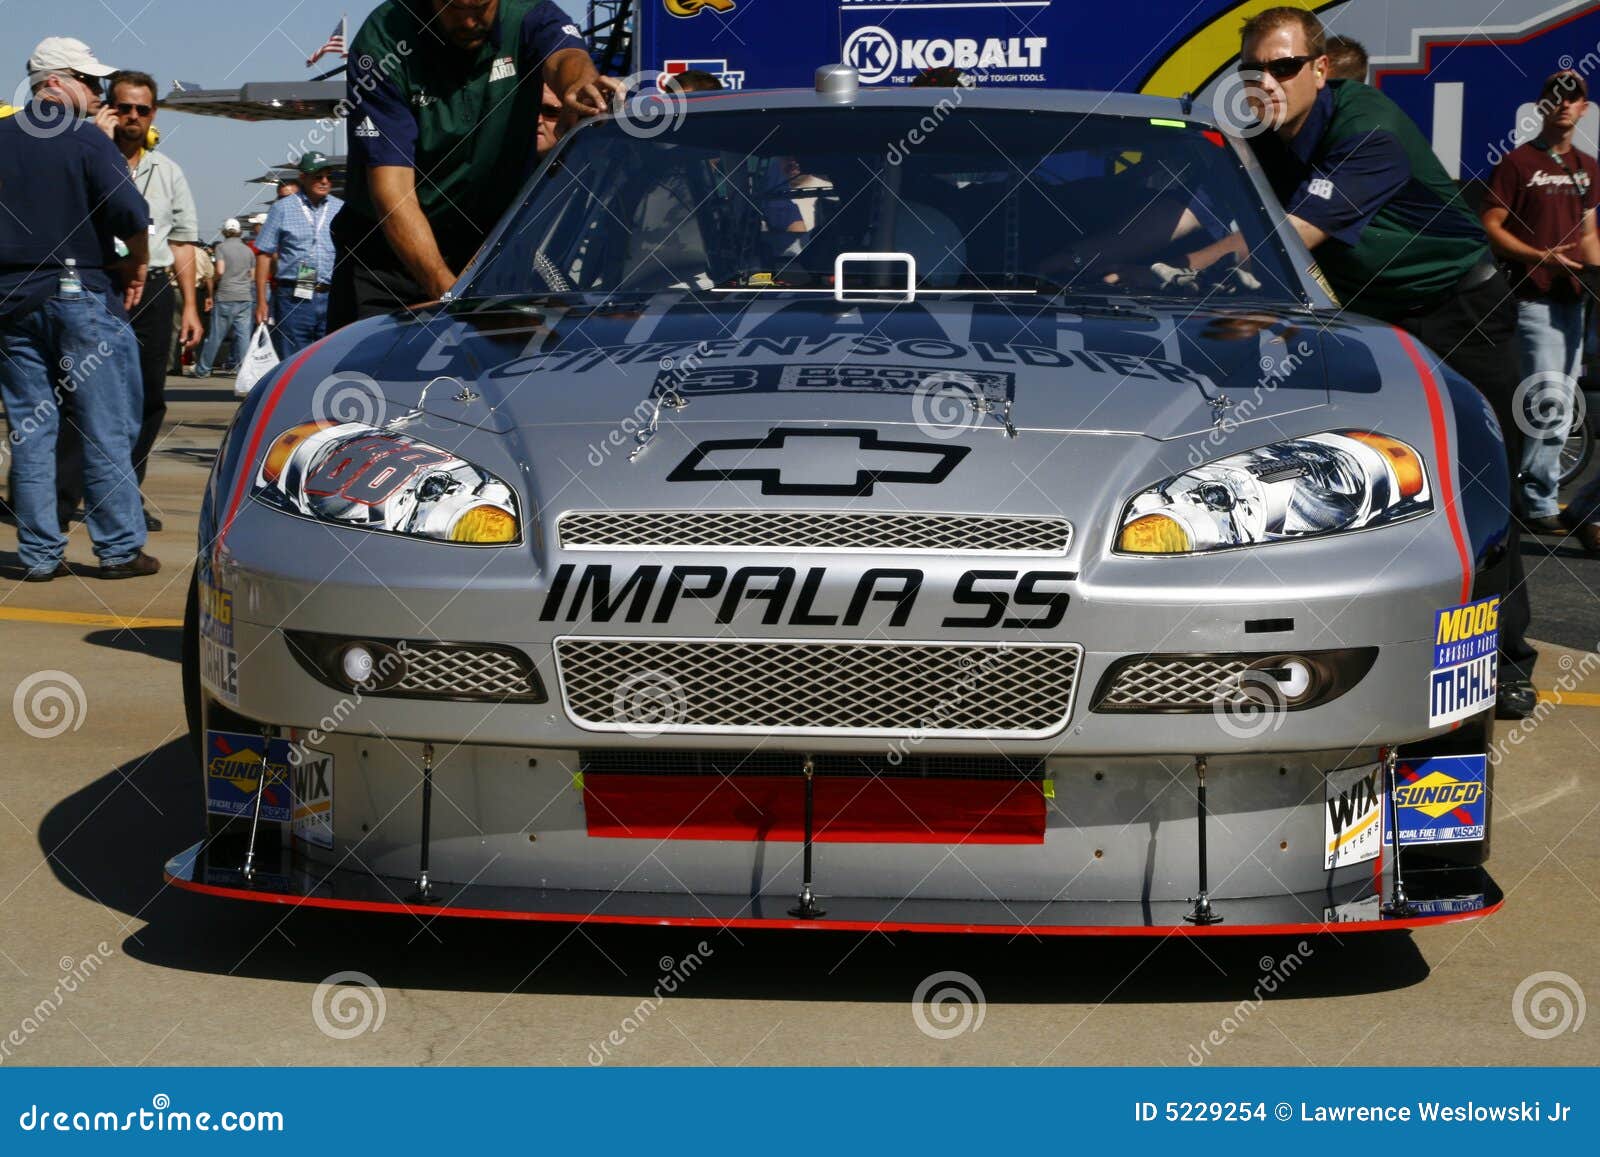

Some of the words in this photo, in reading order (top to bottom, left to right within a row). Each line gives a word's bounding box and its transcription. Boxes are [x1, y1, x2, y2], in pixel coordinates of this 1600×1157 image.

[901, 37, 1047, 70] KOBALT
[990, 74, 1017, 83] TOUGH
[1018, 74, 1046, 83] TOOLS.
[1308, 178, 1333, 200] 88
[485, 335, 1204, 385] CITIZEN/SOLDIER
[538, 563, 924, 627] IMPALA
[941, 569, 1079, 629] SS
[1436, 598, 1499, 645] MOOG
[1440, 641, 1474, 665] CHASSIS
[1431, 653, 1497, 717] MAHLE
[1328, 767, 1379, 835] WIX
[1396, 784, 1480, 806] SUNOCO
[1328, 821, 1379, 865] FILTERS
[1419, 828, 1437, 839] FUEL
